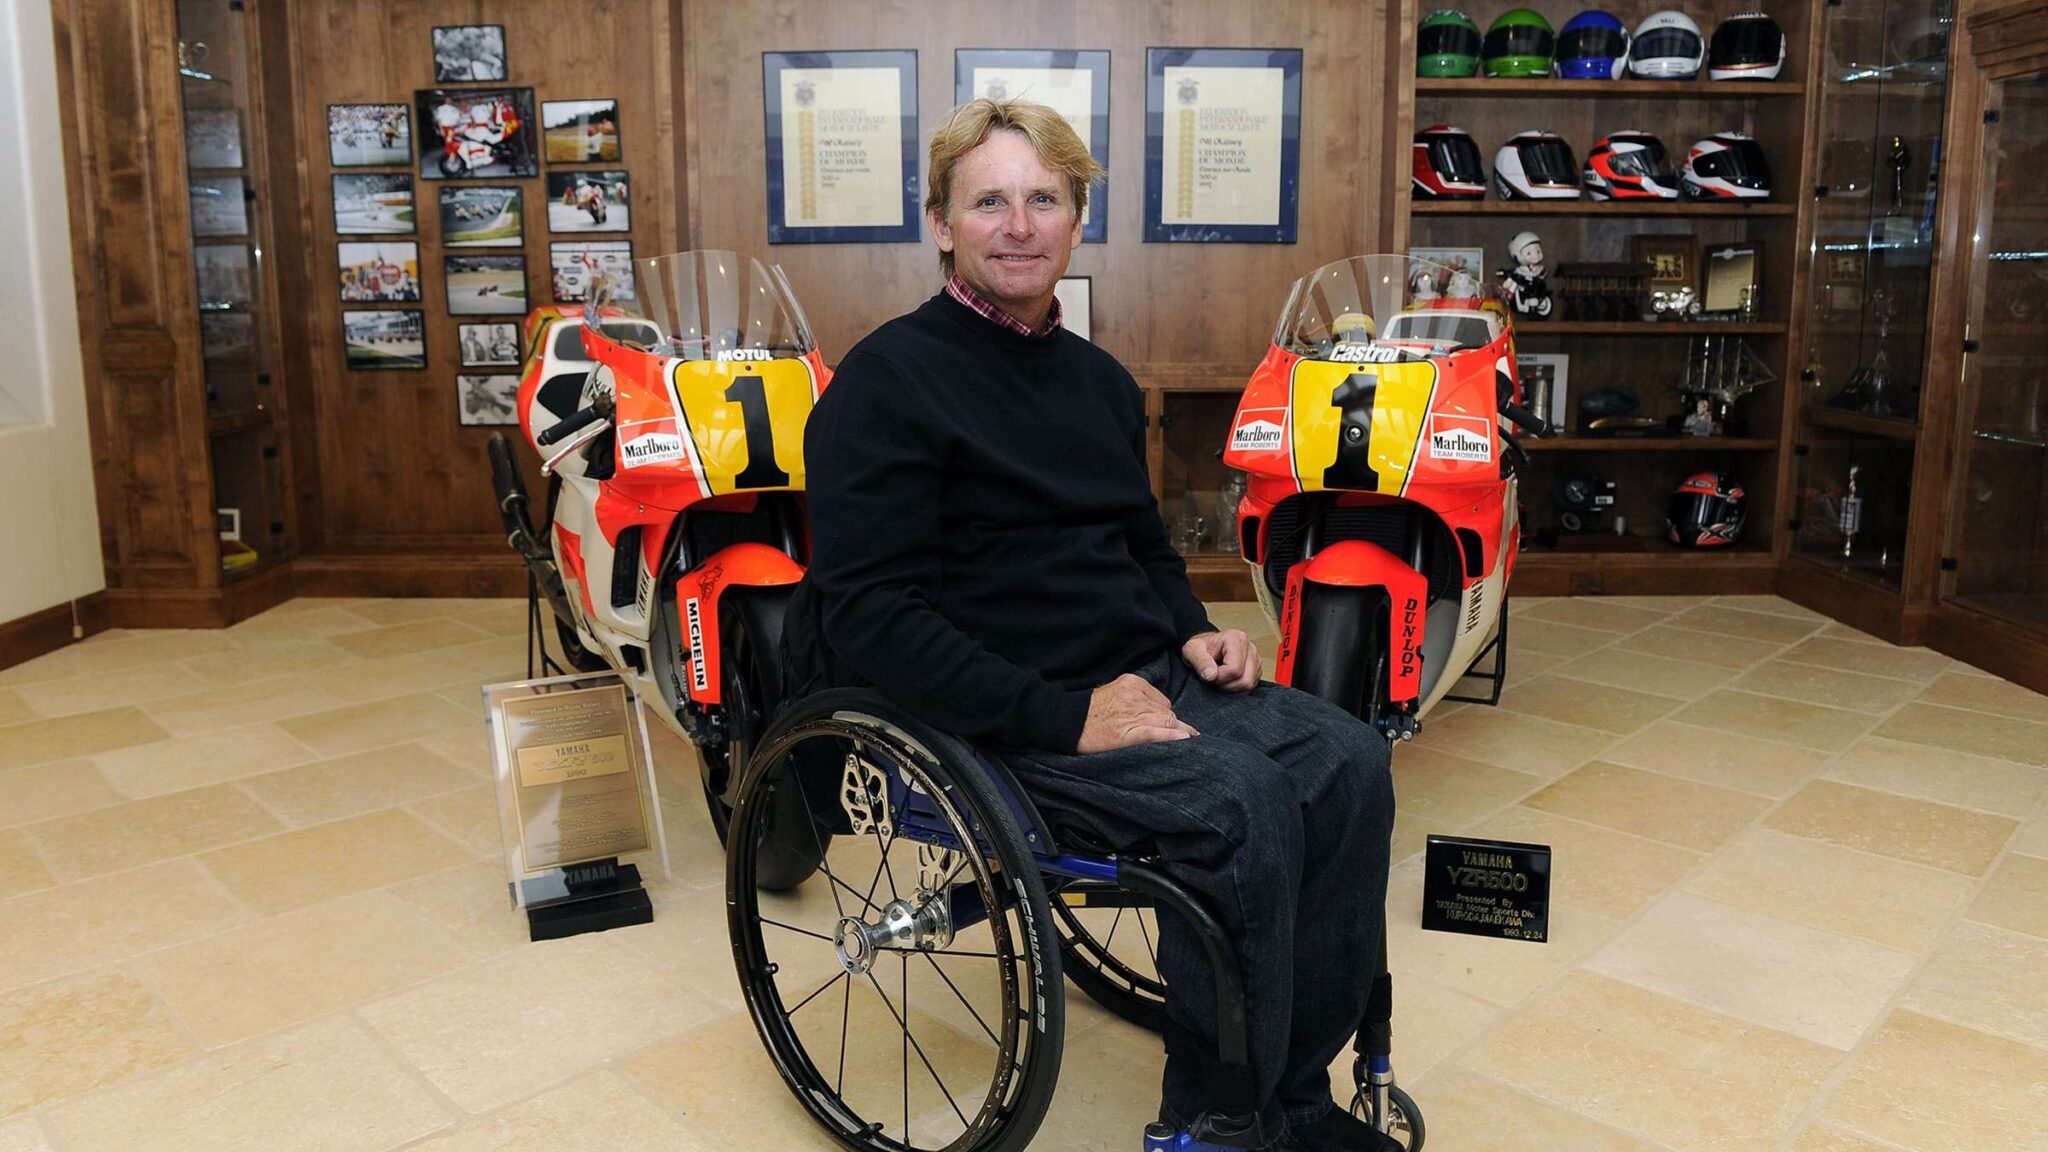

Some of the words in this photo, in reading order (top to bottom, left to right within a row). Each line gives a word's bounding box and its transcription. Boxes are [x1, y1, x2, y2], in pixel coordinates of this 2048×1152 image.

[717, 349, 773, 362] MOTUL
[1329, 343, 1401, 363] Castrol
[725, 376, 790, 489] 1
[1234, 425, 1281, 442] Marlboro
[1323, 373, 1379, 492] 1
[625, 438, 680, 460] Marlboro
[1433, 434, 1488, 453] Marlboro
[1456, 452, 1488, 460] ROBERTS
[1281, 584, 1297, 661] DUNLOP
[688, 602, 705, 686] MICHELIN
[1400, 598, 1418, 677] DUNLOP
[555, 743, 591, 757] YAMAHA
[1462, 851, 1513, 869] YAMAHA
[567, 864, 616, 884] YAMAHA
[1447, 865, 1528, 892] YZR500
[1456, 893, 1496, 906] Presented
[1502, 898, 1513, 908] By
[1492, 906, 1519, 918] Sports
[1013, 878, 1046, 1034] SCHWALBE
